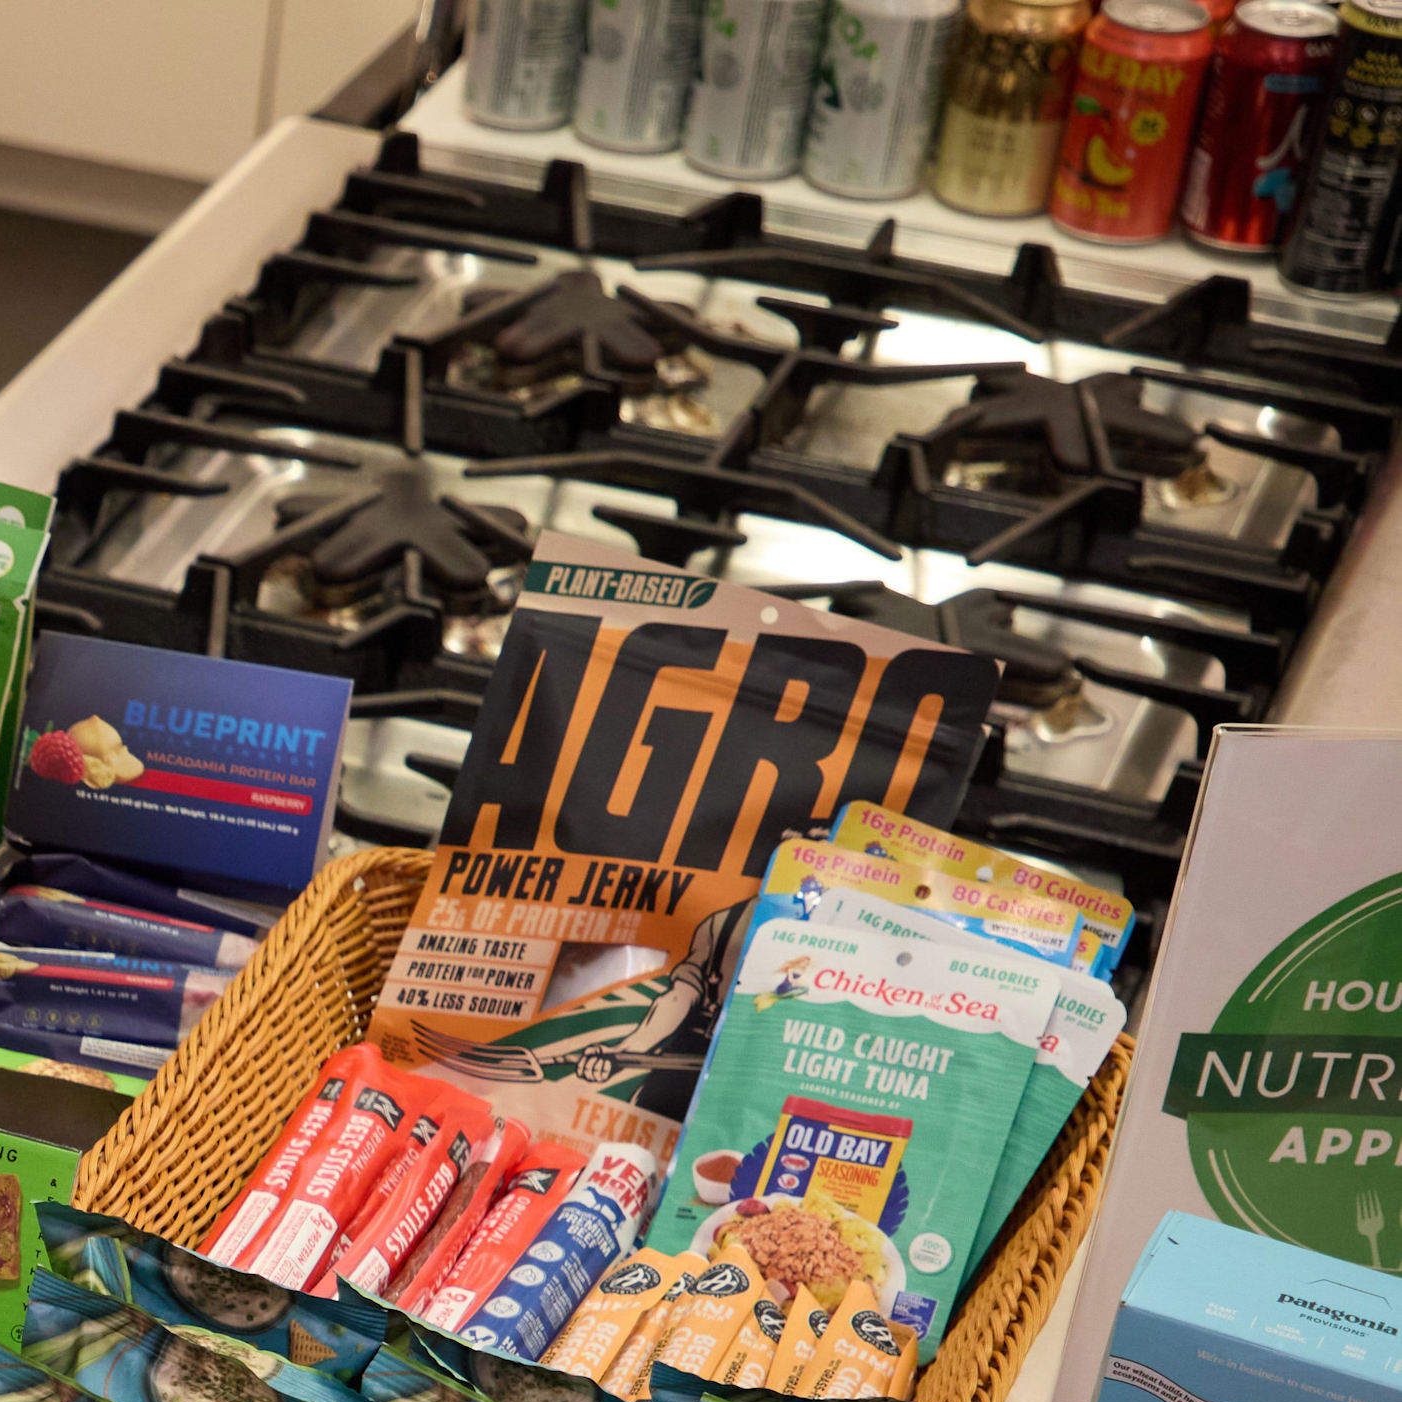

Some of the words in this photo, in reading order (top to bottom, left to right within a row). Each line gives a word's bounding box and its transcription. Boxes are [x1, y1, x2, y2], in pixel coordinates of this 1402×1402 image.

[544, 565, 687, 607] PLANT-BASED
[124, 700, 326, 755] BLUEPRINT
[438, 608, 1006, 878] AGRO
[147, 752, 227, 774] MACADAMIA
[229, 764, 287, 784] PROTEIN
[289, 774, 317, 788] BAR
[250, 792, 306, 810] RASPBERRY
[861, 809, 898, 841] 16g
[898, 818, 966, 864] Protein
[440, 851, 563, 903] POWER
[567, 861, 695, 915] JERKY
[1012, 867, 1042, 891] 80
[1045, 872, 1122, 922] Calories
[470, 900, 503, 930] OF
[506, 903, 613, 941] PROTEIN
[771, 930, 798, 946] 14G
[799, 932, 859, 956] PROTEIN
[417, 934, 477, 954] AMAZING
[481, 940, 527, 960] TASTE
[814, 967, 924, 1008] Chicken
[950, 992, 999, 1024] Sea
[782, 1018, 848, 1055] WILD
[852, 1033, 955, 1076] CAUGHT
[782, 1049, 862, 1086] LIGHT
[864, 1063, 930, 1102] TUNA
[1197, 1050, 1402, 1102] NUTR
[338, 1114, 374, 1146] BEEF
[570, 1098, 657, 1148] TEXAS
[786, 1122, 832, 1153] OLD
[837, 1132, 886, 1168] BAY
[1268, 1126, 1402, 1167] APP
[306, 1147, 354, 1198] STICKS
[816, 1159, 880, 1189] SEASONING
[487, 1195, 531, 1245] ORIGINAL
[557, 1211, 612, 1258] PREMIUM
[1112, 1369, 1159, 1393] ecosystems
[1160, 1387, 1178, 1402] and
[1113, 1360, 1131, 1373] Our
[1131, 1364, 1159, 1382] wheat
[1158, 1379, 1183, 1399] builds
